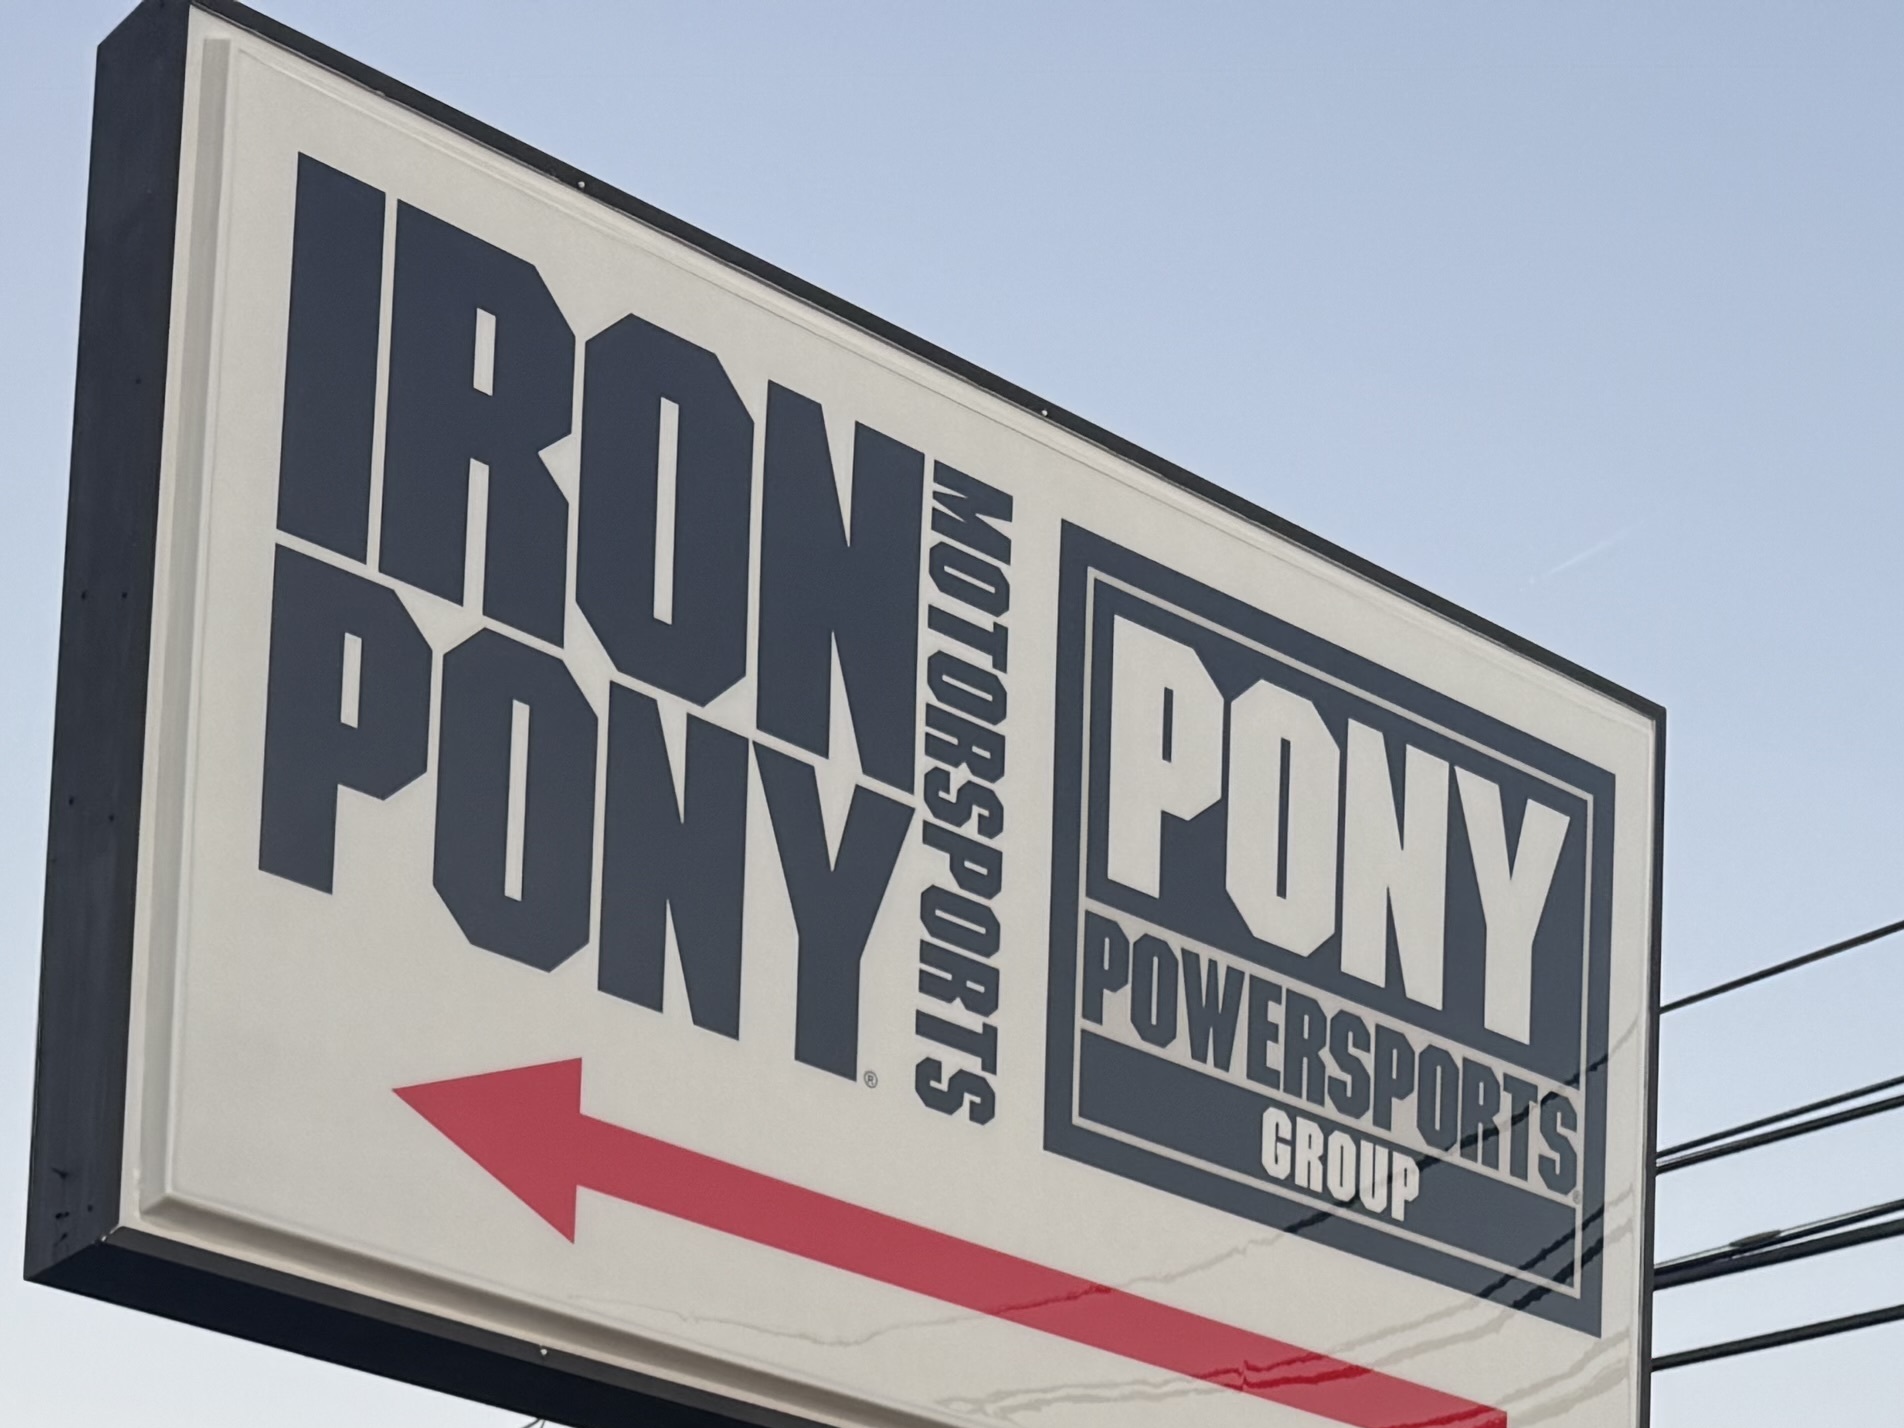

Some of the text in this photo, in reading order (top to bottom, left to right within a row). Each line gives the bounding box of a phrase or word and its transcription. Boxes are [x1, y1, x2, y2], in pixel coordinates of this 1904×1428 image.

[276, 151, 926, 794] IRON
[259, 543, 916, 1083] PONY
[915, 459, 1014, 1127] MOTORSPORTS
[1107, 612, 1571, 1047] PONY
[1081, 909, 1579, 1197] POWERSPORTS
[1261, 1106, 1420, 1222] GROUP
